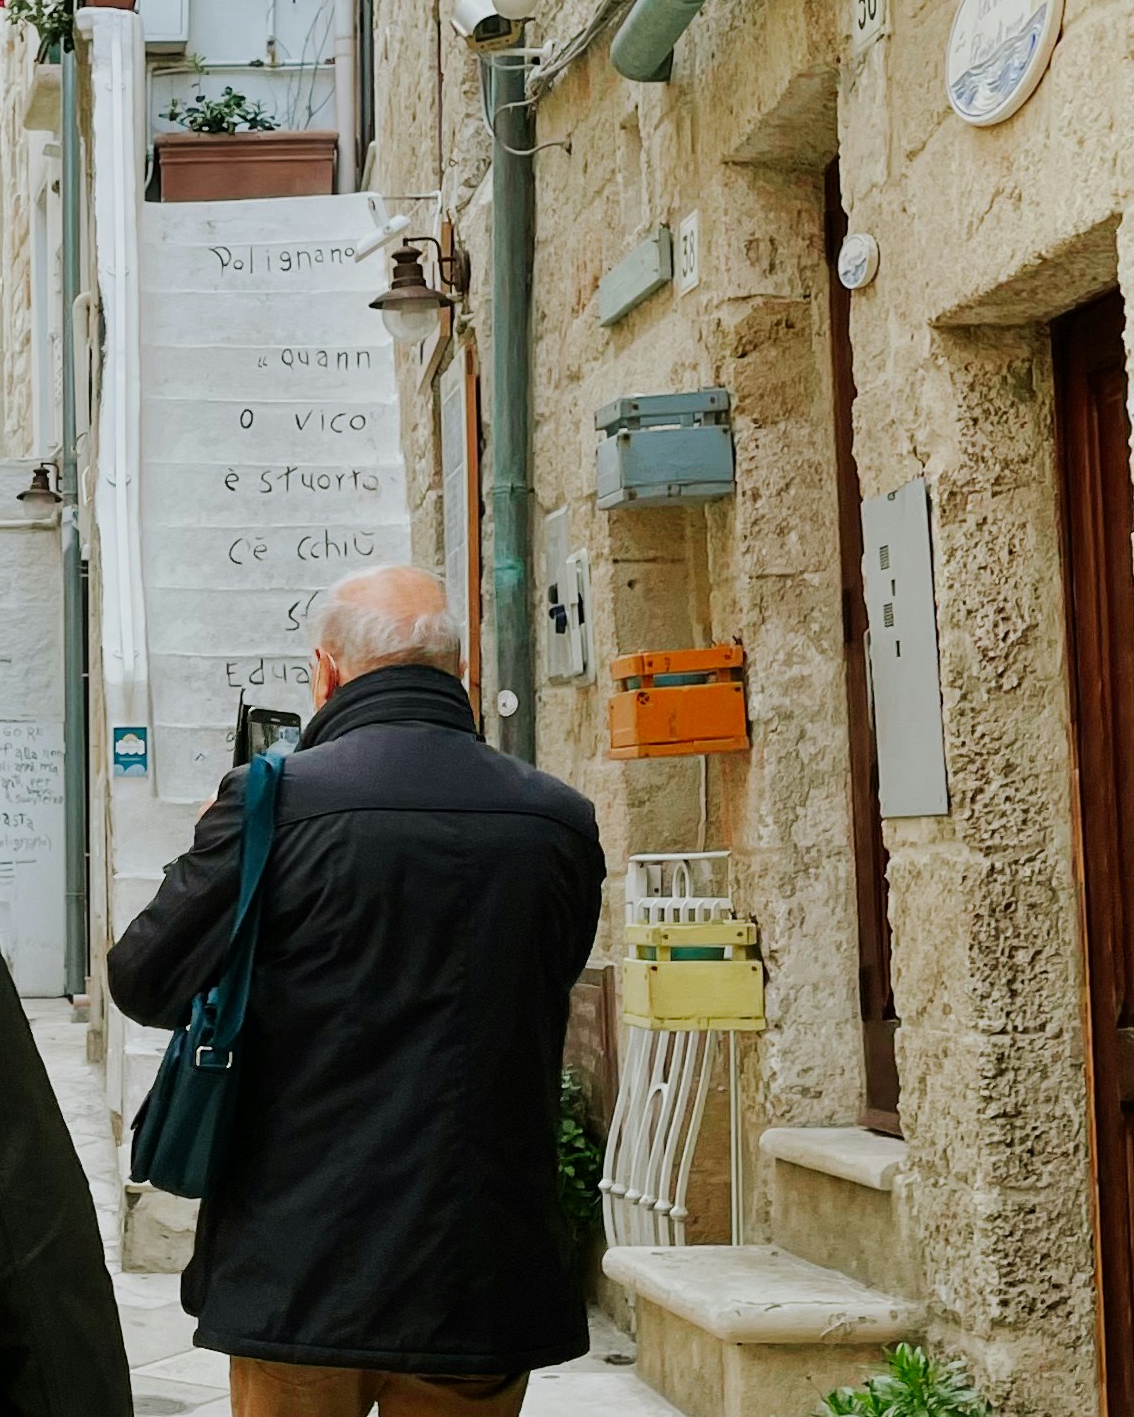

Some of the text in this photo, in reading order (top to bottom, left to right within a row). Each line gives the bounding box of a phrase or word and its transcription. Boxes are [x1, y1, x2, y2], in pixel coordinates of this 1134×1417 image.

[208, 245, 355, 277] Polignano
[682, 229, 696, 278] 38
[226, 658, 313, 688] Edua
